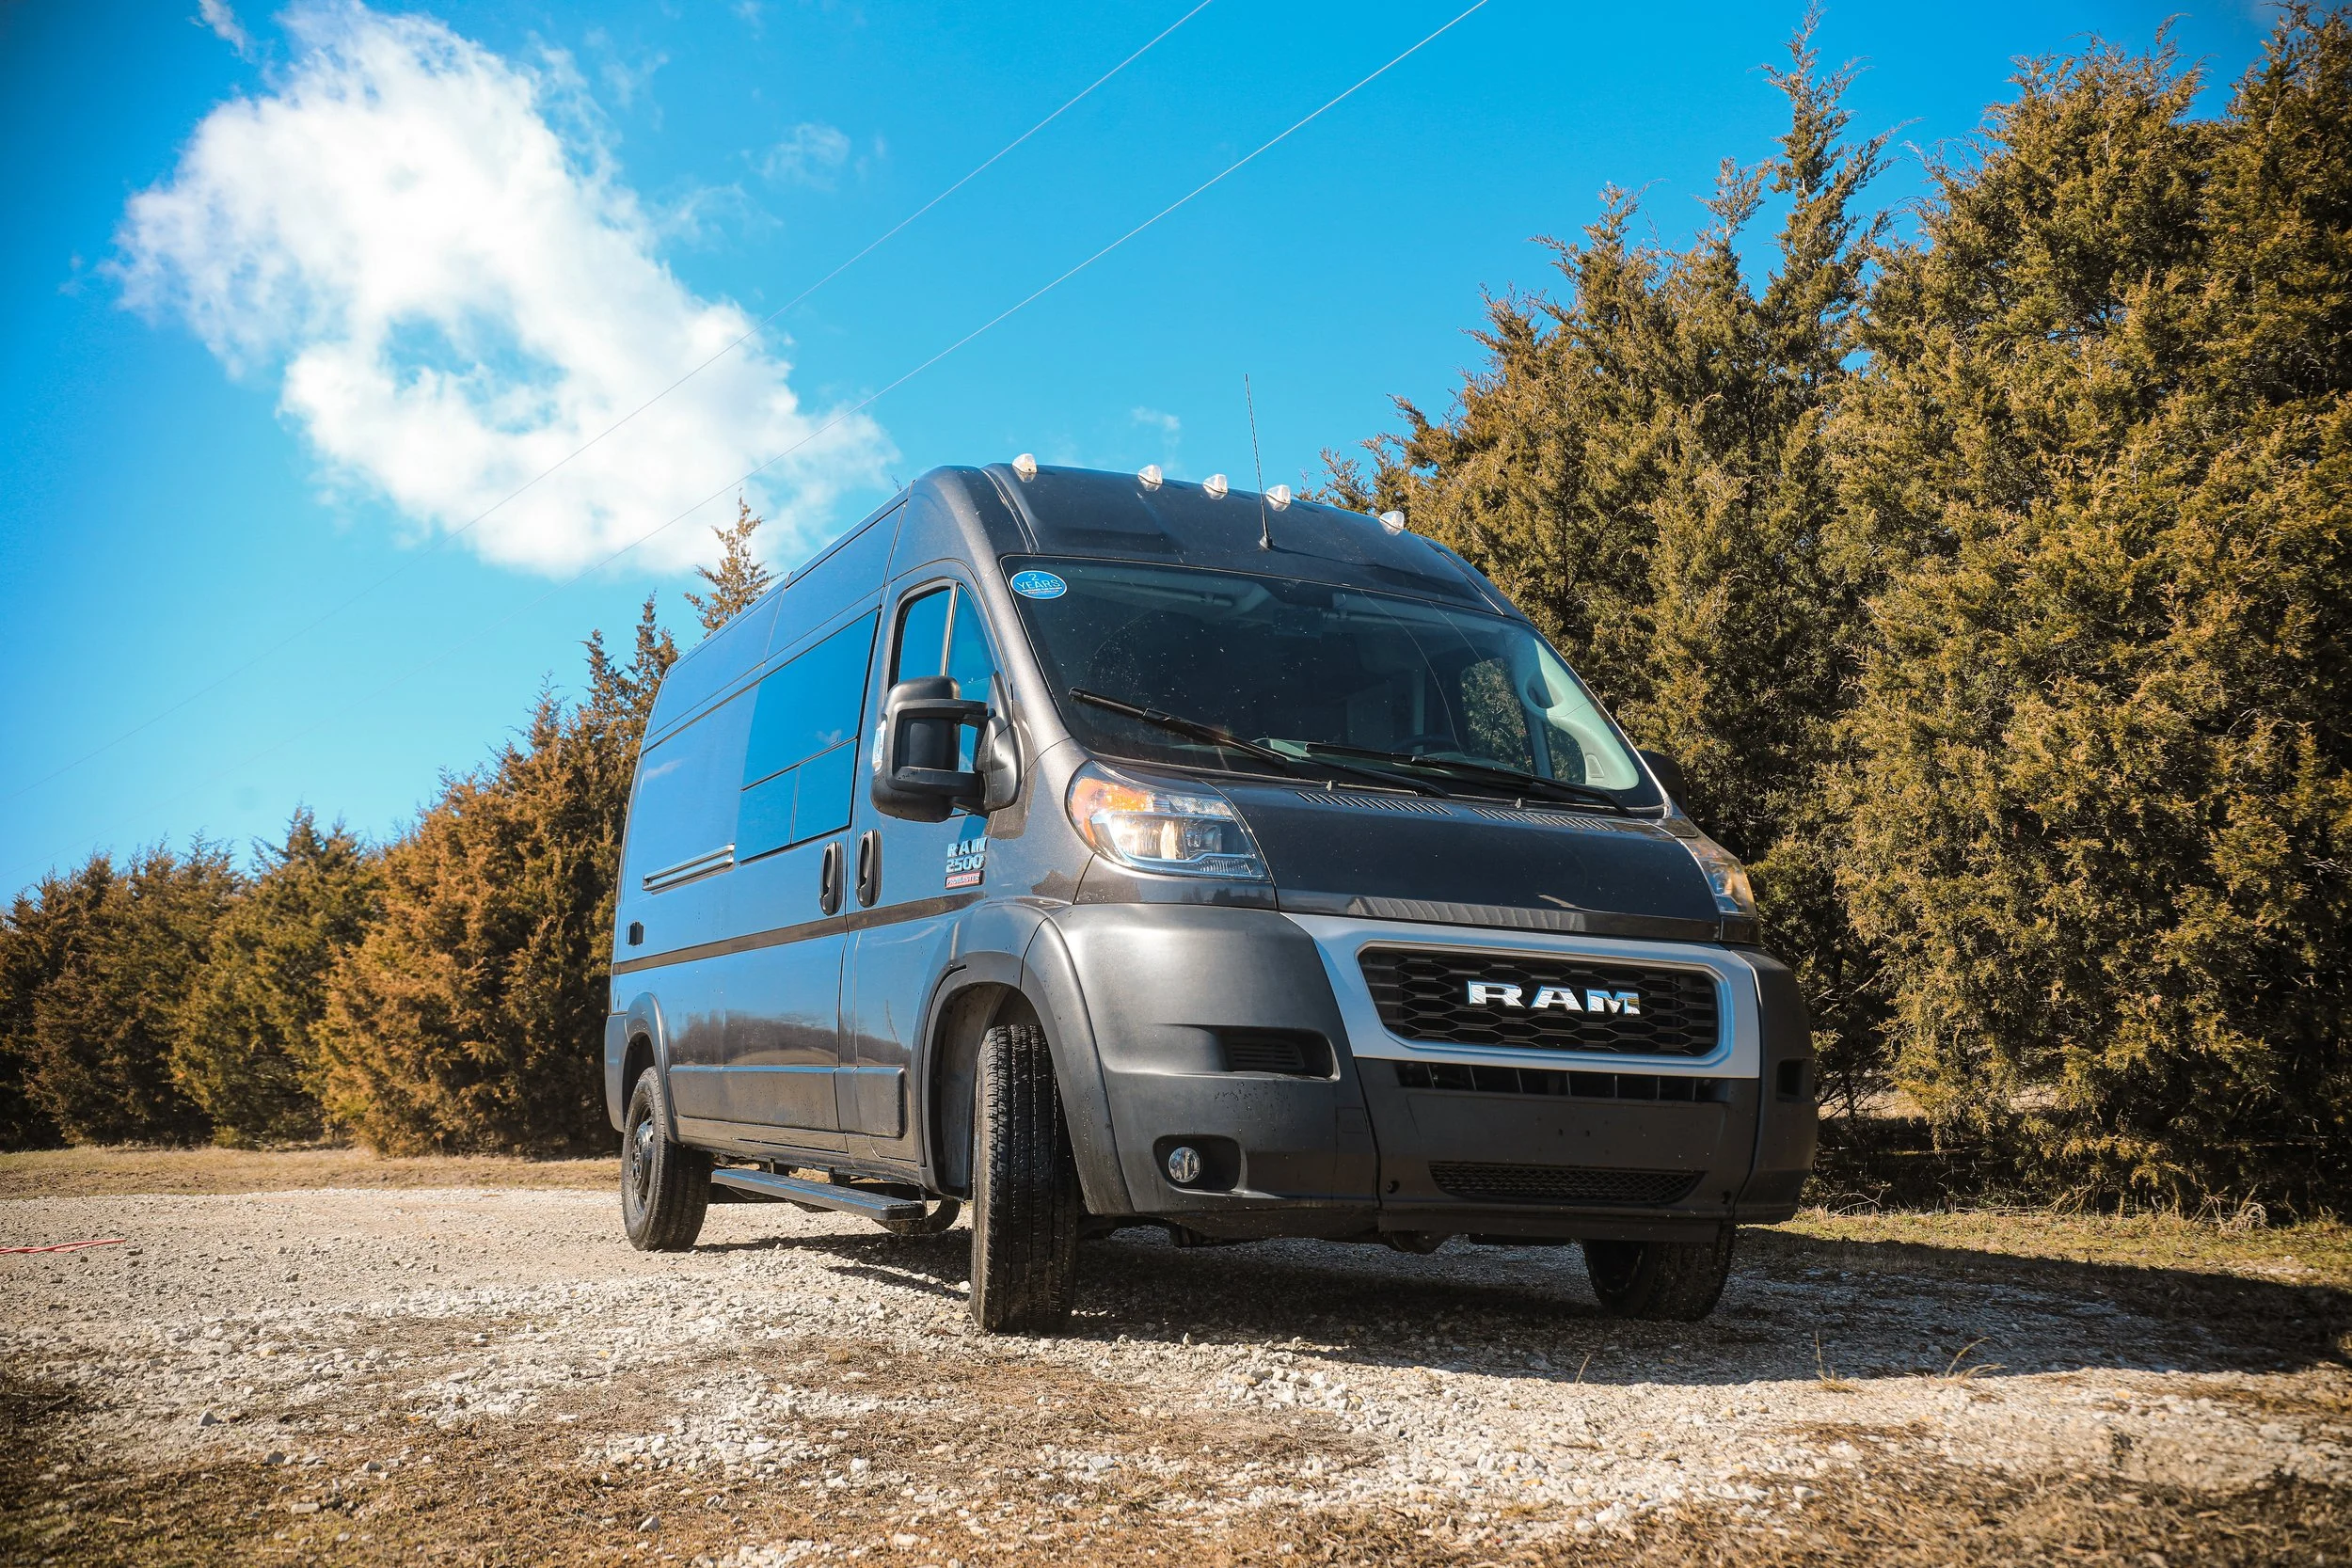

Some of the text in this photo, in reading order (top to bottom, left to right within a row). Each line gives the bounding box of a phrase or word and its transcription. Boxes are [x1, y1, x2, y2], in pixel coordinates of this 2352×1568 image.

[1016, 579, 1060, 590] YEARS
[1028, 573, 1039, 581] 2
[947, 837, 988, 857] RAM
[946, 854, 985, 873] 2500
[1468, 980, 1641, 1016] RAM
